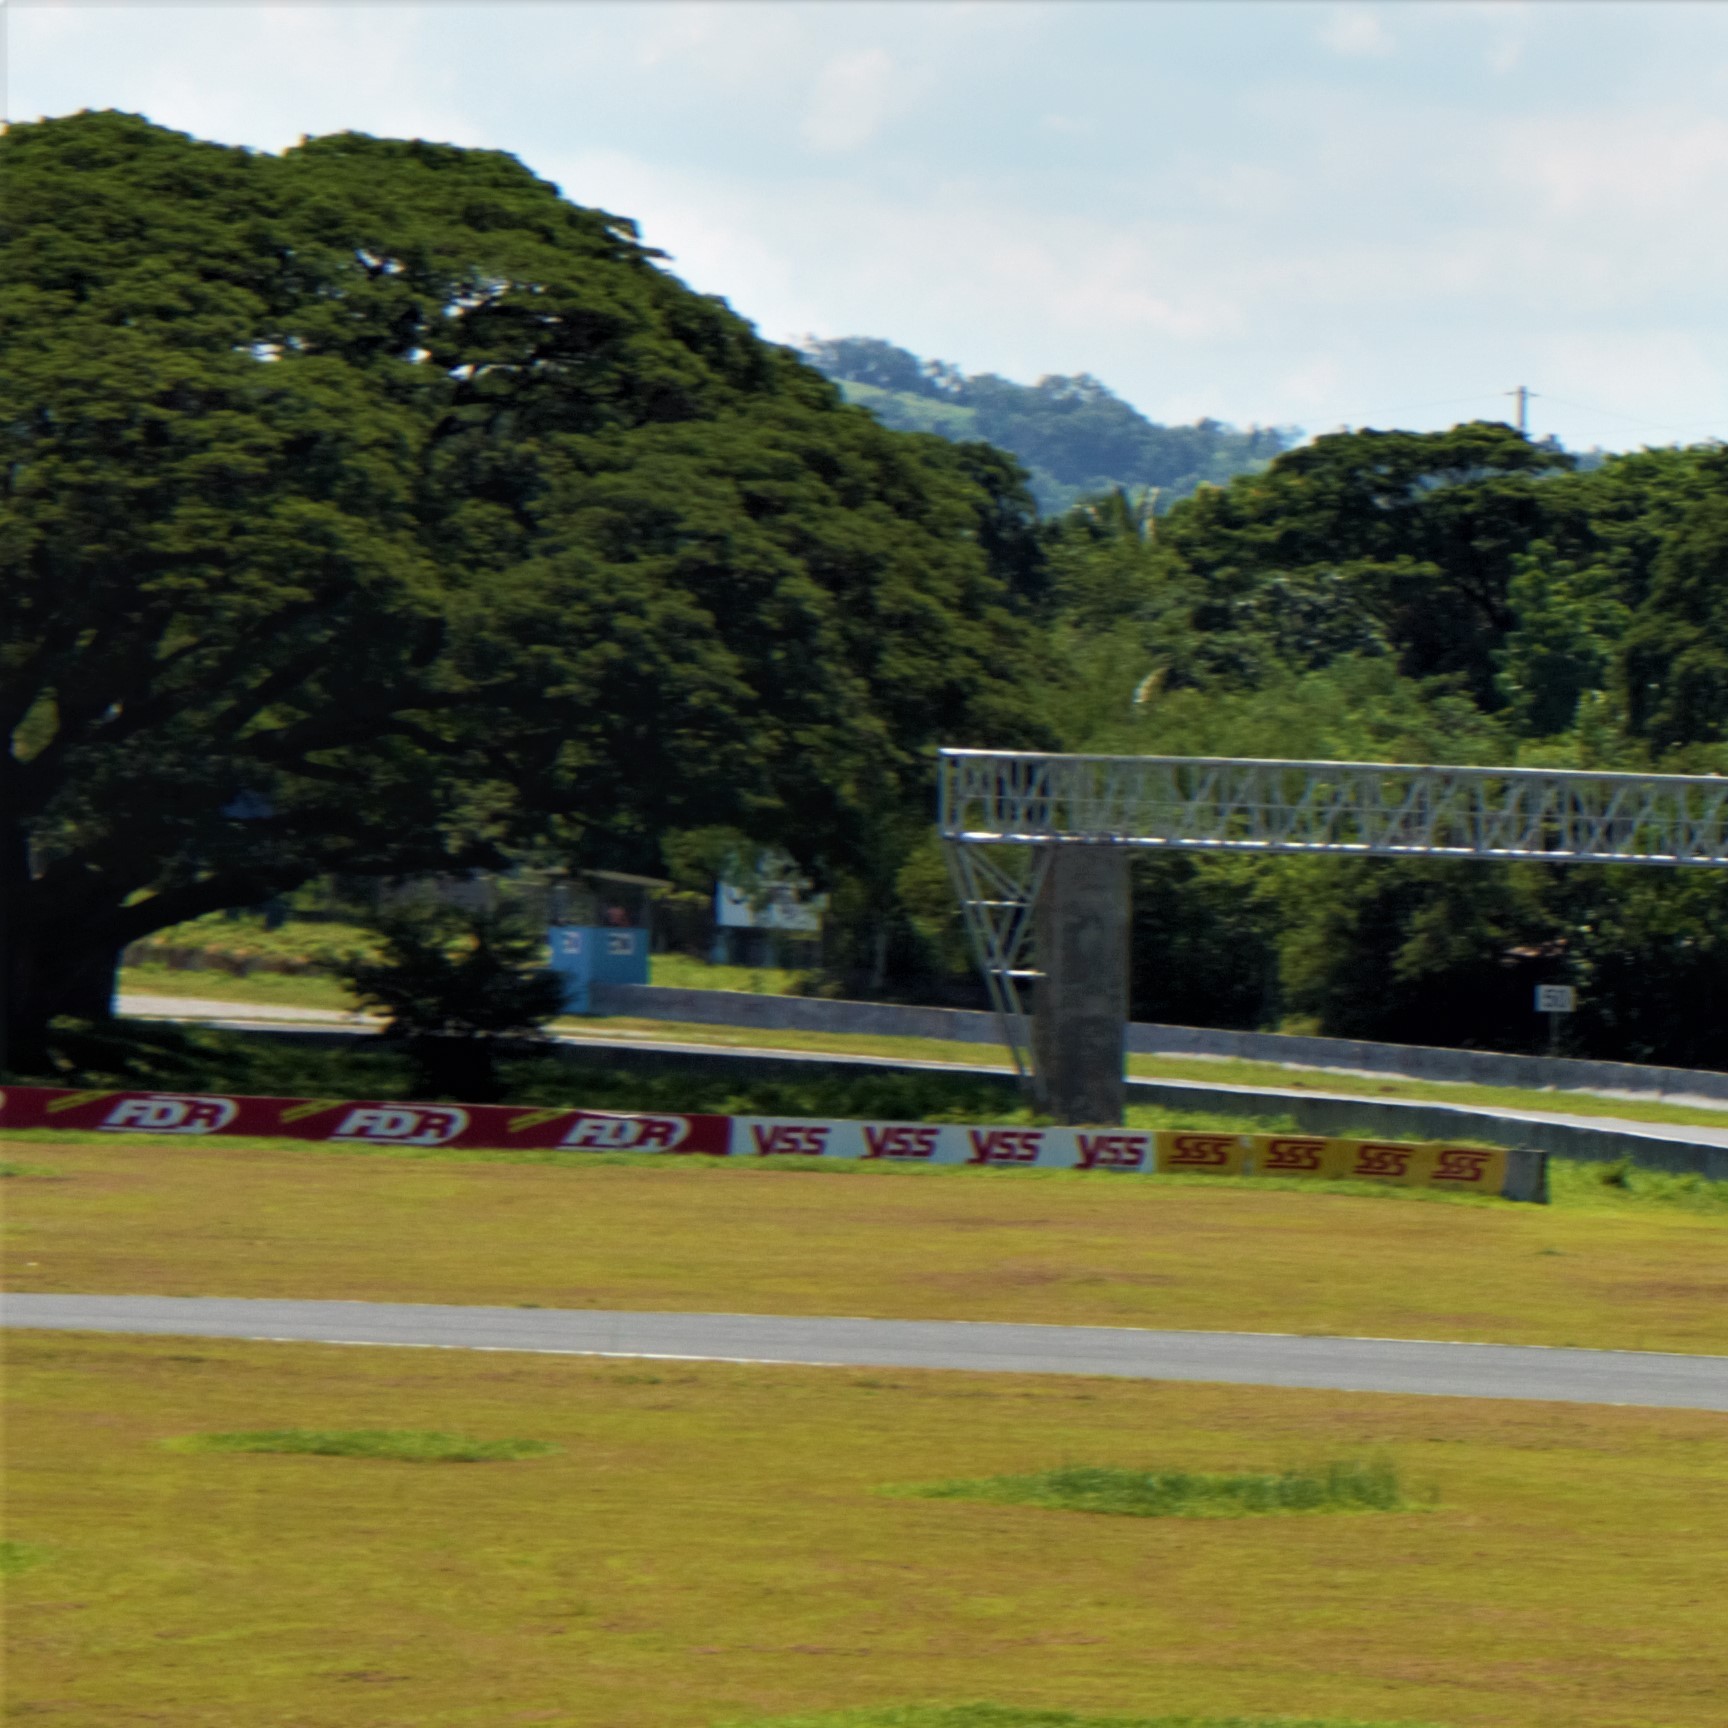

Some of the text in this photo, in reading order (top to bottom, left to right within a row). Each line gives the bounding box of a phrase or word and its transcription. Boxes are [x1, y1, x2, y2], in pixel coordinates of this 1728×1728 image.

[98, 1095, 238, 1133] FDR
[329, 1101, 469, 1146] FDR
[556, 1109, 691, 1152] FDR
